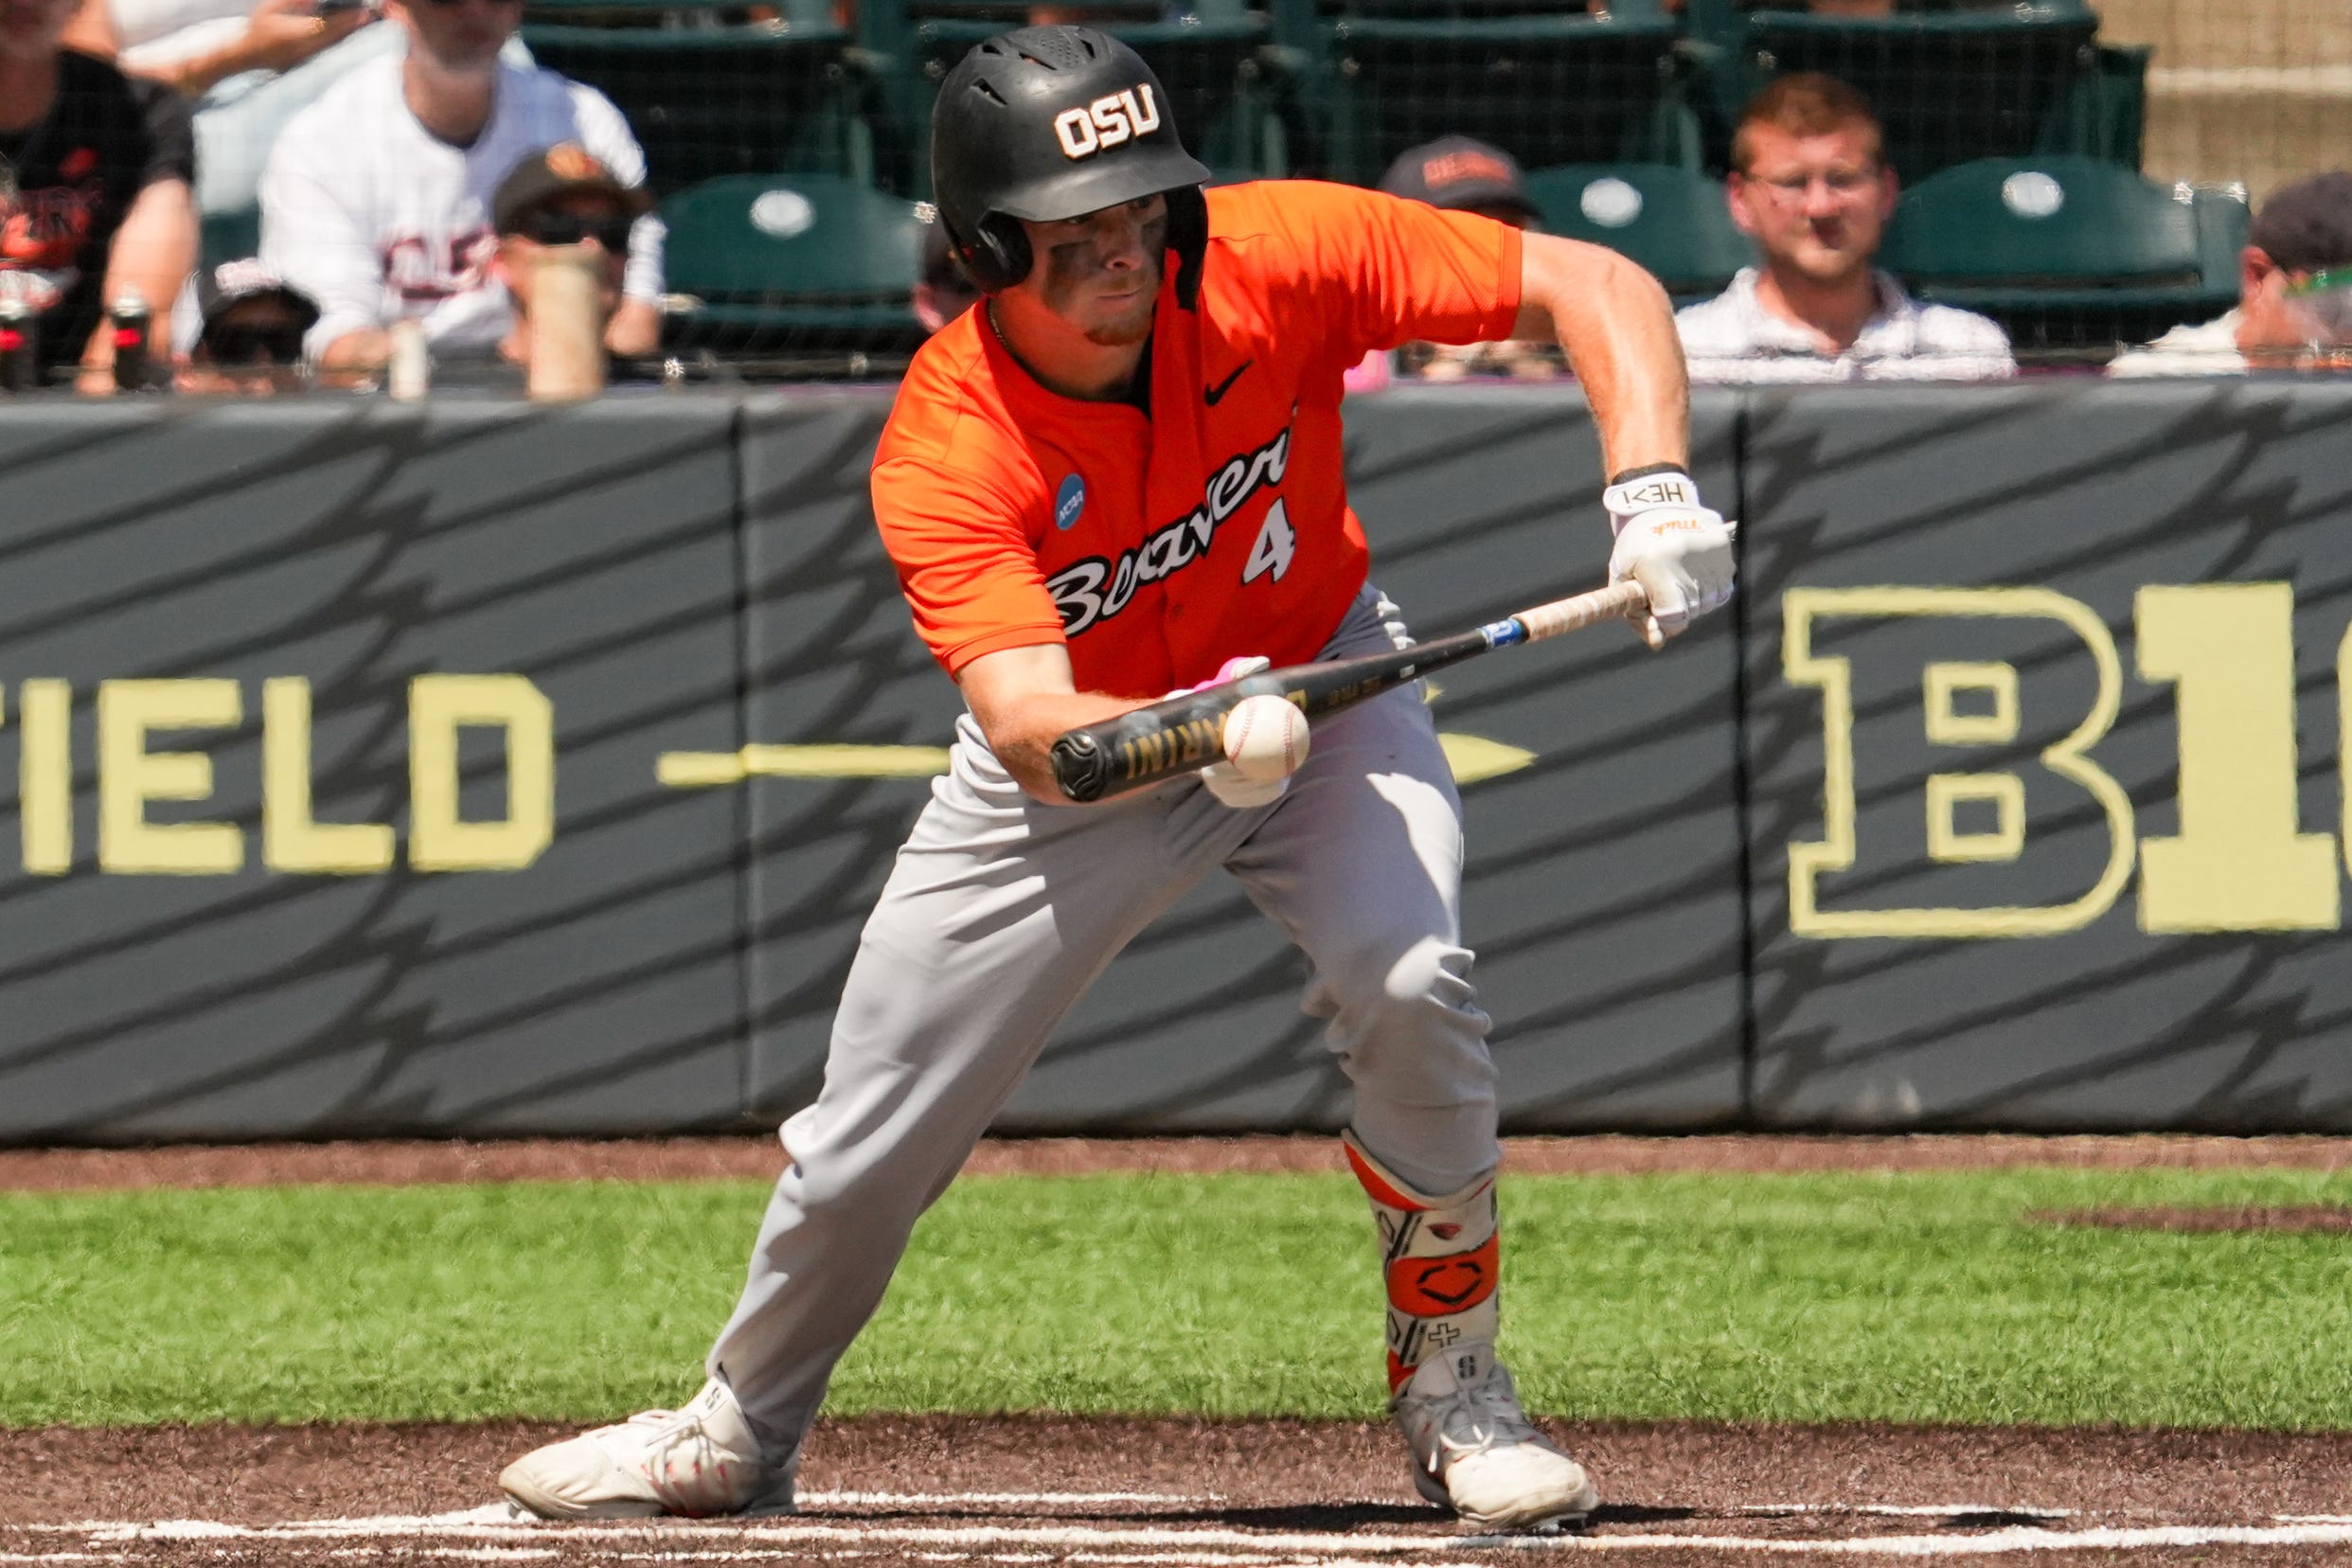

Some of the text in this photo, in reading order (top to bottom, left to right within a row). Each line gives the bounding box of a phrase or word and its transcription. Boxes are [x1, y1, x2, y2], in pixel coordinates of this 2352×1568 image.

[1053, 82, 1161, 160] OSU
[1043, 401, 1298, 638] Beaver
[1241, 494, 1295, 586] 4
[0, 673, 557, 876] IELD
[1784, 582, 2352, 939] B1
